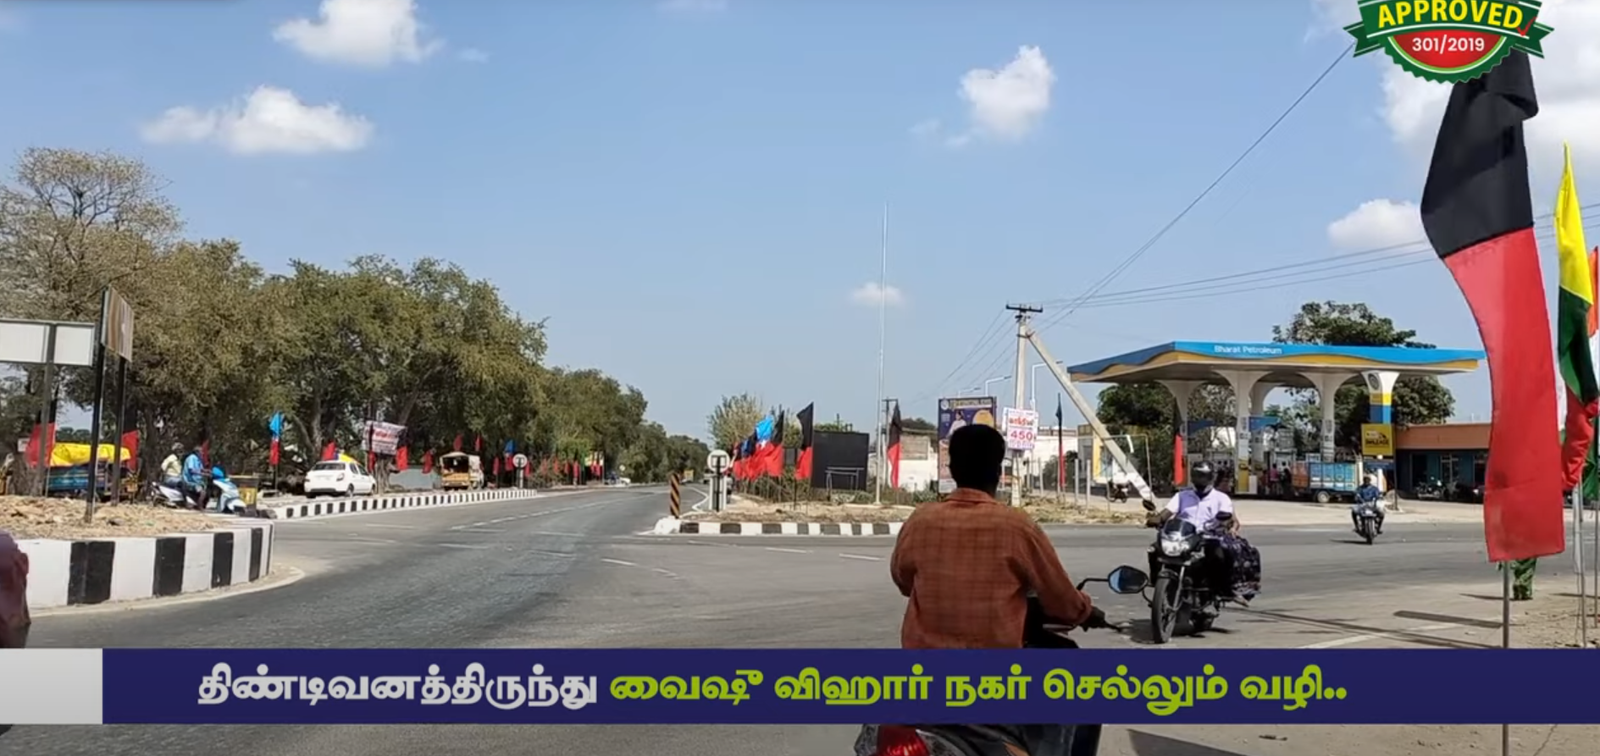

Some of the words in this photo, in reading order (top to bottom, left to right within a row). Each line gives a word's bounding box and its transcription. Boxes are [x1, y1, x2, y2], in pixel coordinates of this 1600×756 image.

[1214, 345, 1241, 353] Bharat
[1243, 345, 1282, 354] Petroleum
[1010, 430, 1033, 441] 450
